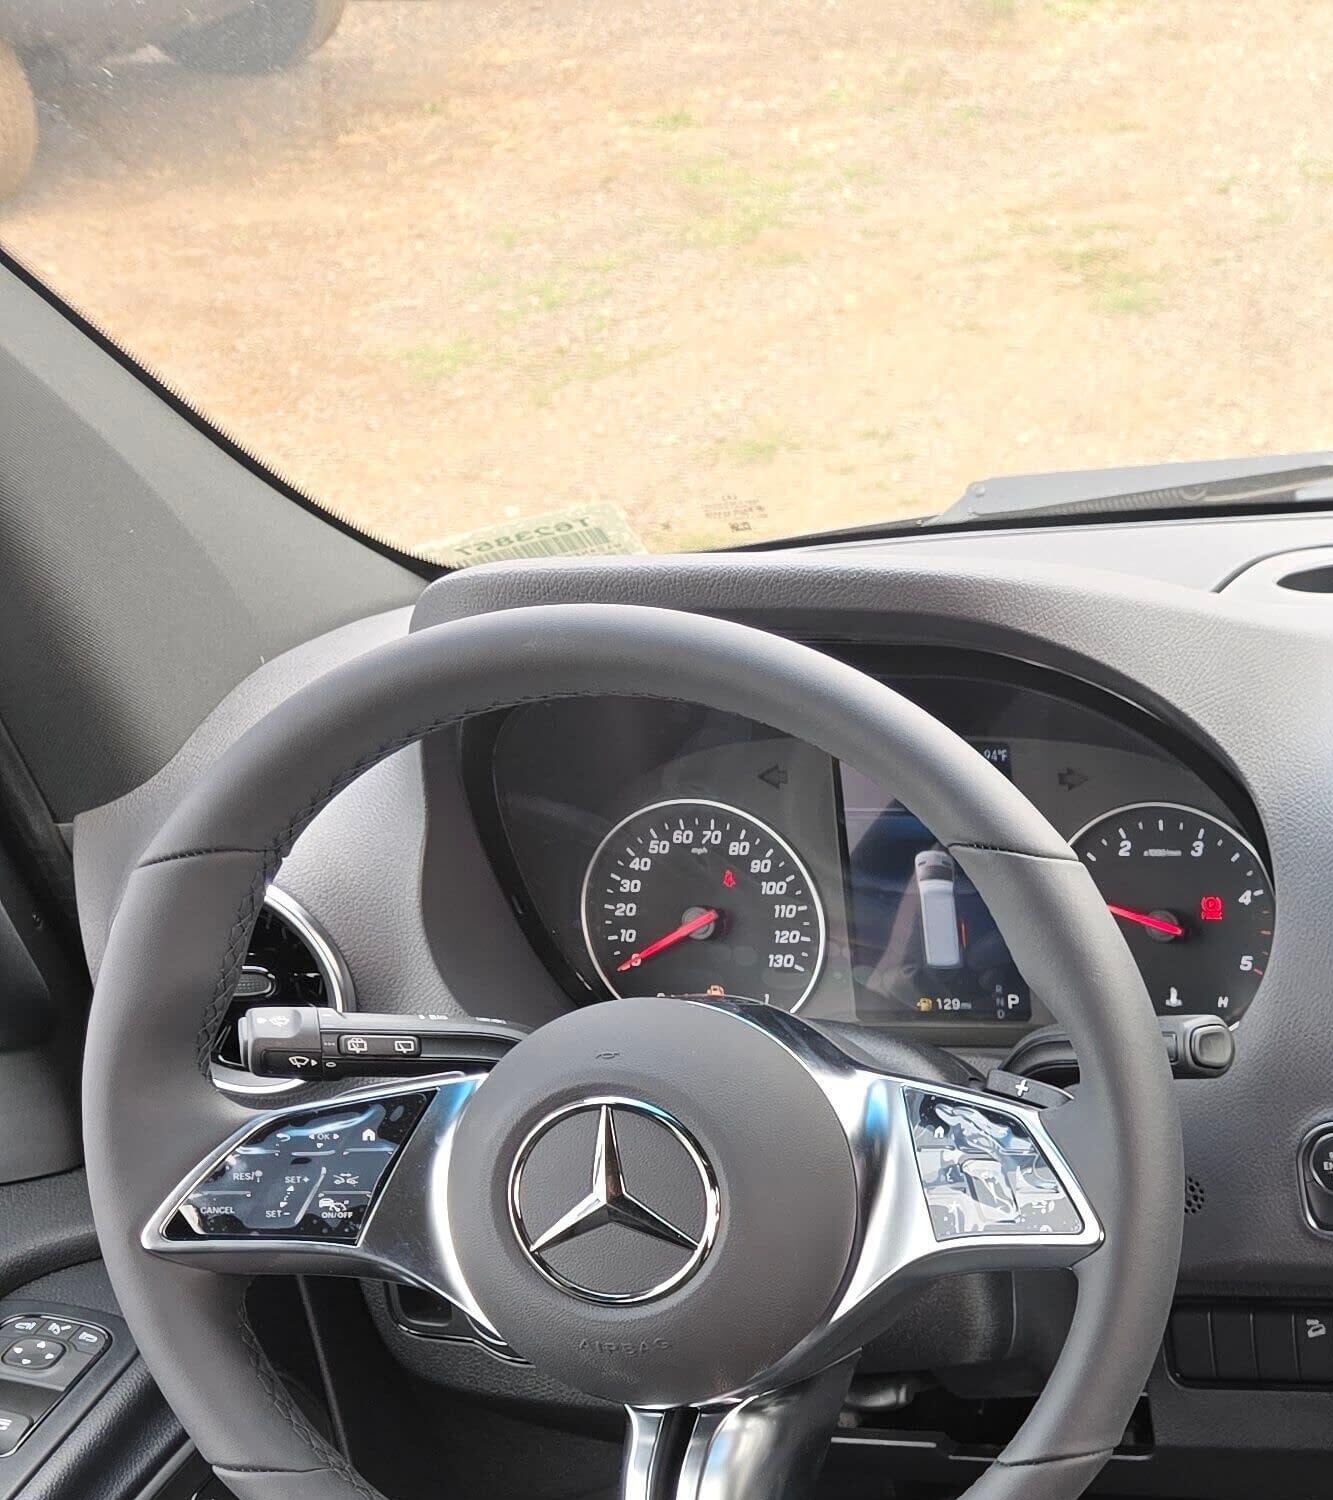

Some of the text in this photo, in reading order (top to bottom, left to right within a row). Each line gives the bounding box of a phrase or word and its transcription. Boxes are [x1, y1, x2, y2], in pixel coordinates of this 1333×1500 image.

[672, 830, 693, 844] 60
[702, 830, 722, 844] 70
[649, 840, 670, 854] 50
[729, 842, 750, 856] 80
[1118, 840, 1132, 856] 2
[1190, 841, 1204, 856] 3
[629, 858, 651, 870] 40
[750, 859, 772, 873] 90
[620, 880, 641, 892] 30
[761, 882, 786, 894] 100
[1238, 890, 1252, 905] 4
[615, 904, 636, 916] 20
[774, 904, 796, 918] 110
[620, 930, 636, 942] 10
[774, 931, 800, 944] 120
[768, 954, 794, 968] 130
[1240, 956, 1253, 971] 5
[936, 998, 960, 1010] 129
[1008, 994, 1019, 1009] P
[201, 1206, 235, 1214] CANCEL
[321, 1211, 353, 1219] ON/OFF
